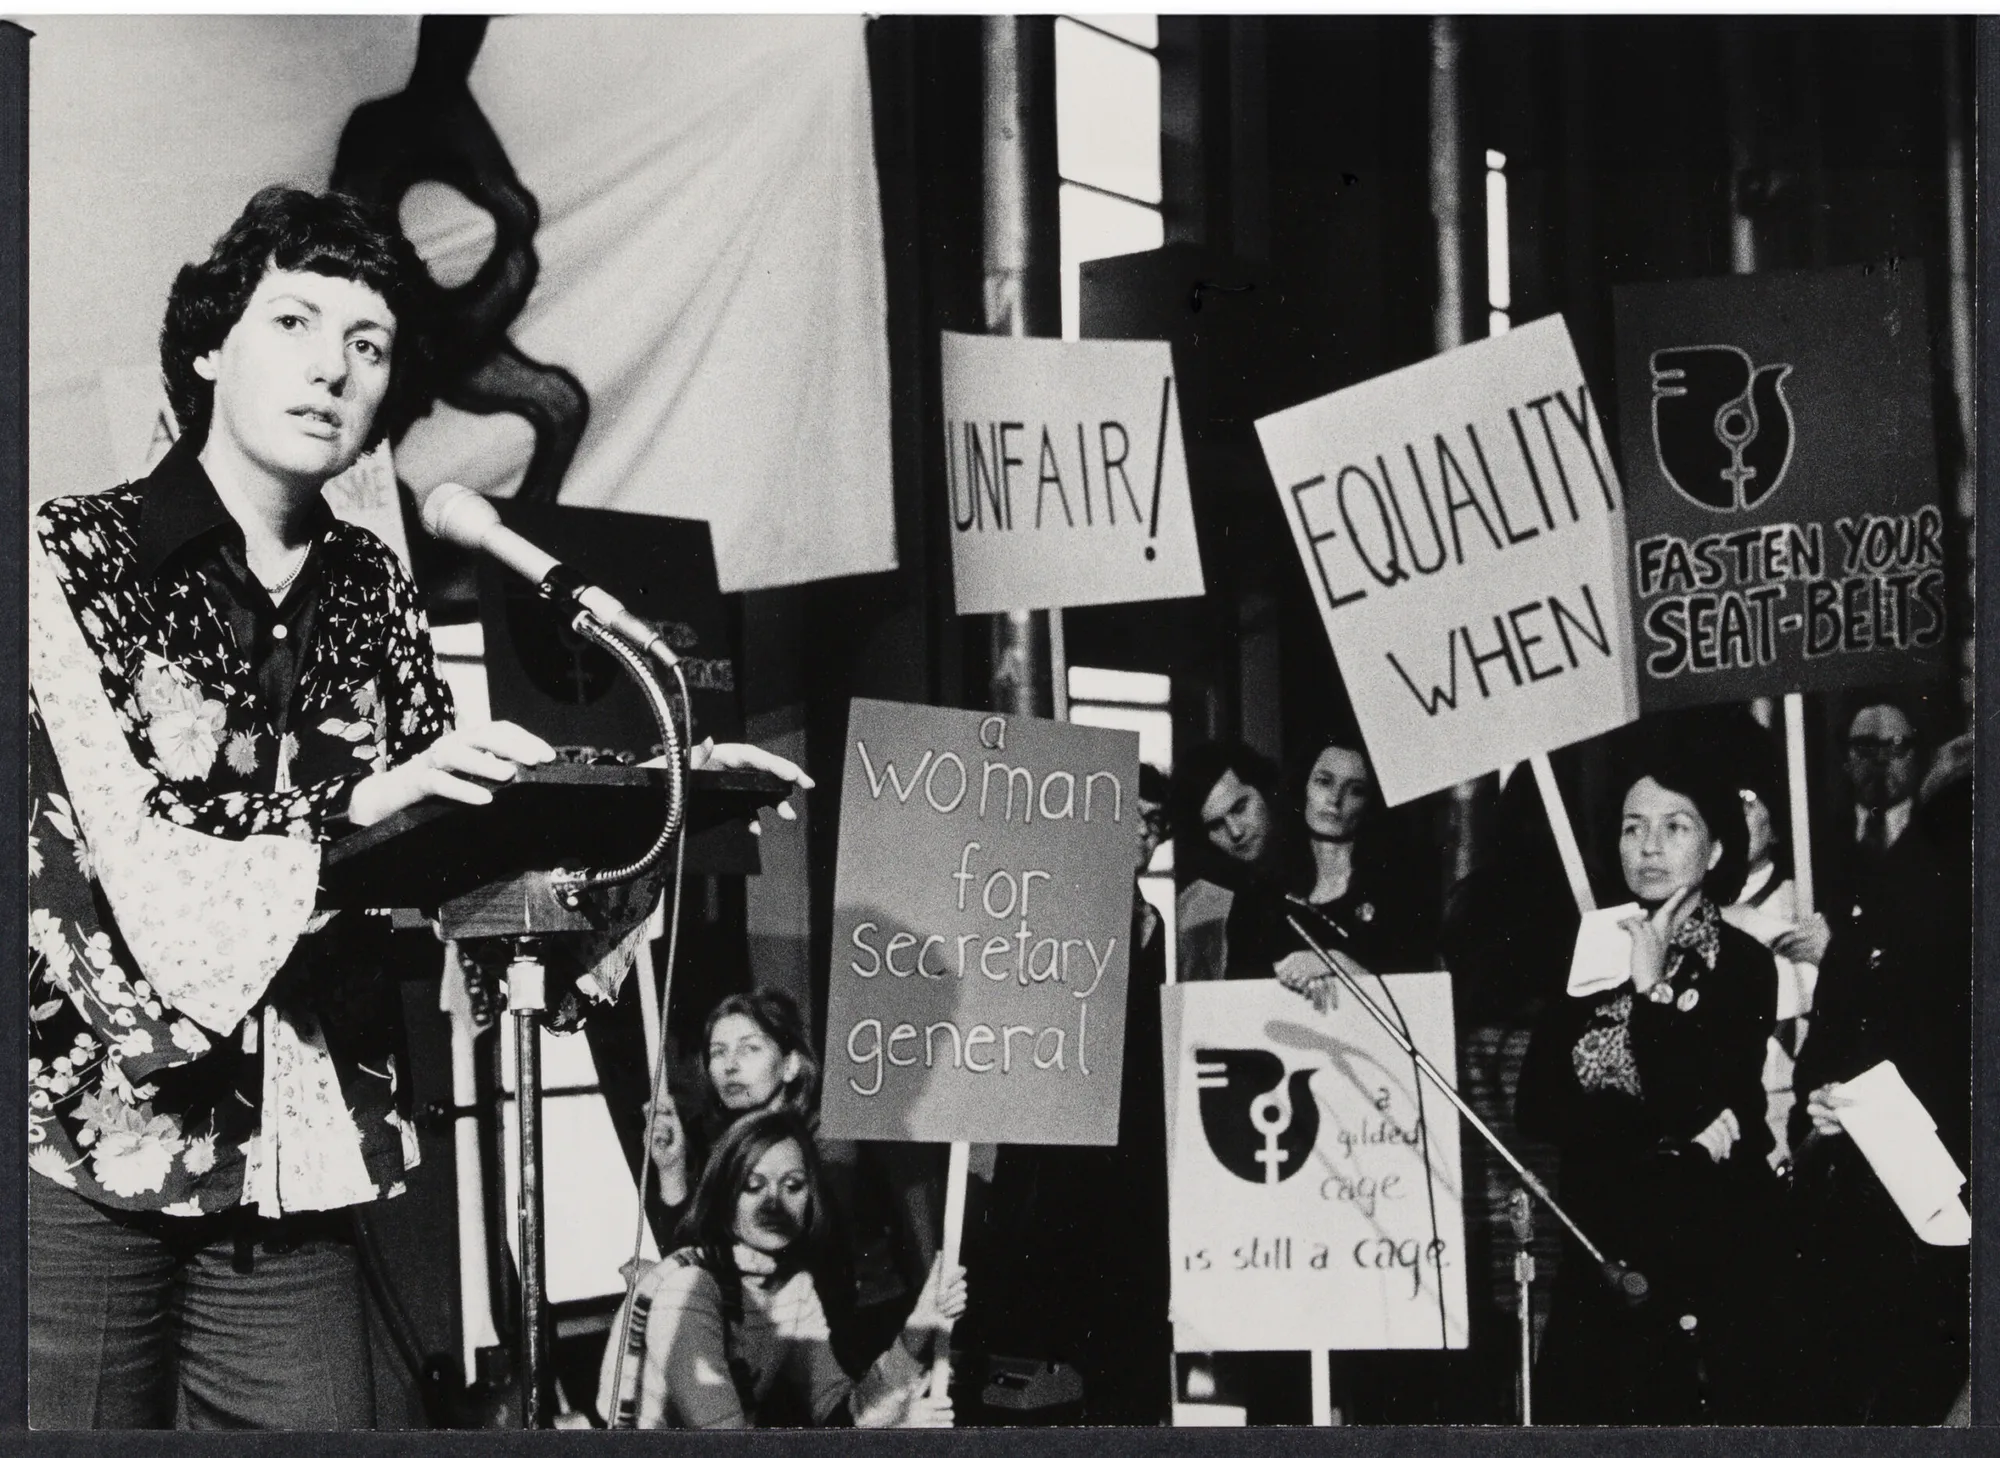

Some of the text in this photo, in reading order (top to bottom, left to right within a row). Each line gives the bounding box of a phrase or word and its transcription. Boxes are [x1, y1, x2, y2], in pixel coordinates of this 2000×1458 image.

[946, 375, 1171, 562] UNFAIR!
[1291, 382, 1615, 609] EQUALITY
[1635, 504, 1944, 599] FASTEN YOUR
[1386, 584, 1612, 716] WHEN
[978, 715, 1007, 750] a
[953, 841, 1051, 919] for
[850, 920, 1117, 999] secretary
[847, 1002, 1092, 1096] general
[1320, 1174, 1406, 1219] cage
[1183, 1236, 1451, 1300] is still a cage
